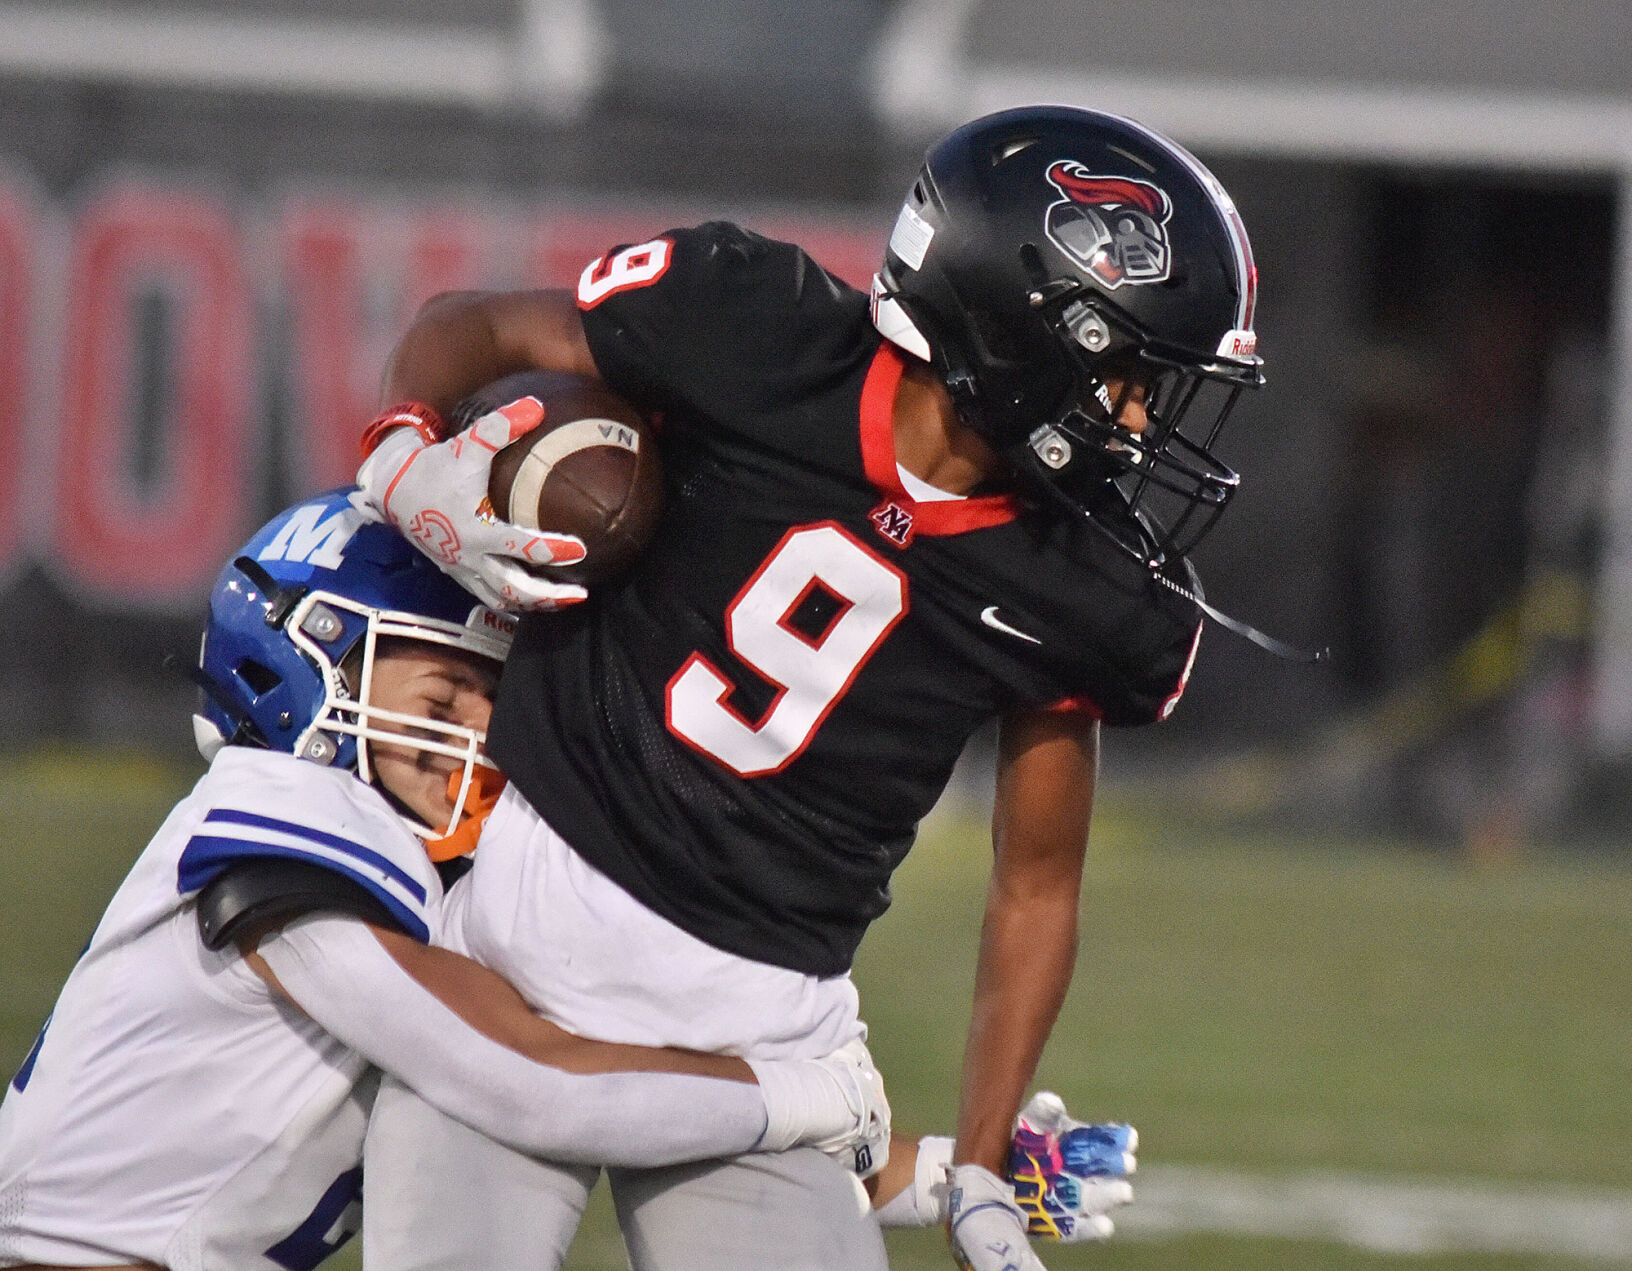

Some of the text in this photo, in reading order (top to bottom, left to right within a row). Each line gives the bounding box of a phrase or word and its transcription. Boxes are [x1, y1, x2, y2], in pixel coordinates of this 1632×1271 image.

[576, 238, 674, 311] 9
[257, 504, 364, 571] M
[665, 519, 909, 777] 9
